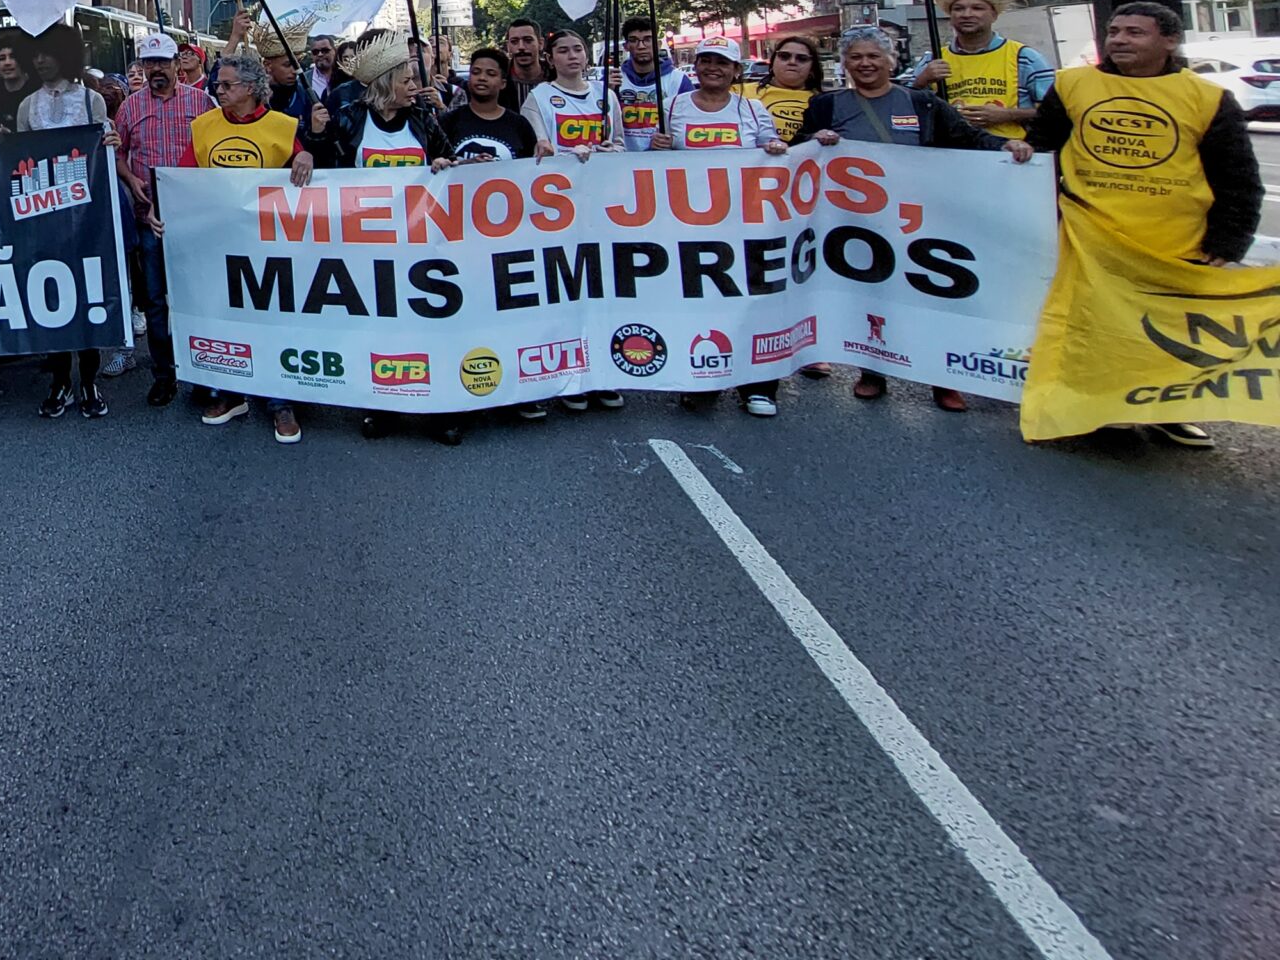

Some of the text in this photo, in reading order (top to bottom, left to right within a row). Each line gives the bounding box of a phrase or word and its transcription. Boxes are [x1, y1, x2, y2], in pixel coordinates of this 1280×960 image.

[1099, 117, 1155, 129] NCST
[686, 127, 740, 144] CTB
[1106, 136, 1147, 147] NOVA
[217, 152, 252, 163] NCST
[1093, 145, 1161, 160] CENTRAL
[14, 181, 87, 217] UMES
[258, 156, 924, 245] MENOS JUROS,
[225, 225, 980, 320] MAIS EMPREGOS
[616, 324, 657, 343] FORÇA
[193, 339, 247, 356] CSP
[583, 337, 591, 368] BRASIL
[843, 340, 912, 364] INTERSINDICAL
[194, 349, 249, 369] Conlutas
[279, 348, 345, 378] CSB
[468, 360, 494, 371] NCST
[520, 339, 583, 376] CUT
[613, 352, 666, 375] SINDICAL
[690, 354, 733, 369] UGT
[374, 359, 427, 381] CTB
[946, 367, 988, 382] CENTRAL
[991, 376, 1006, 385] DO
[281, 373, 303, 381] CENTRAL
[315, 377, 347, 386] SINDICATOS
[297, 380, 329, 389] BRASILEIROS
[467, 381, 498, 391] CENTRAL
[473, 375, 492, 383] NOVA
